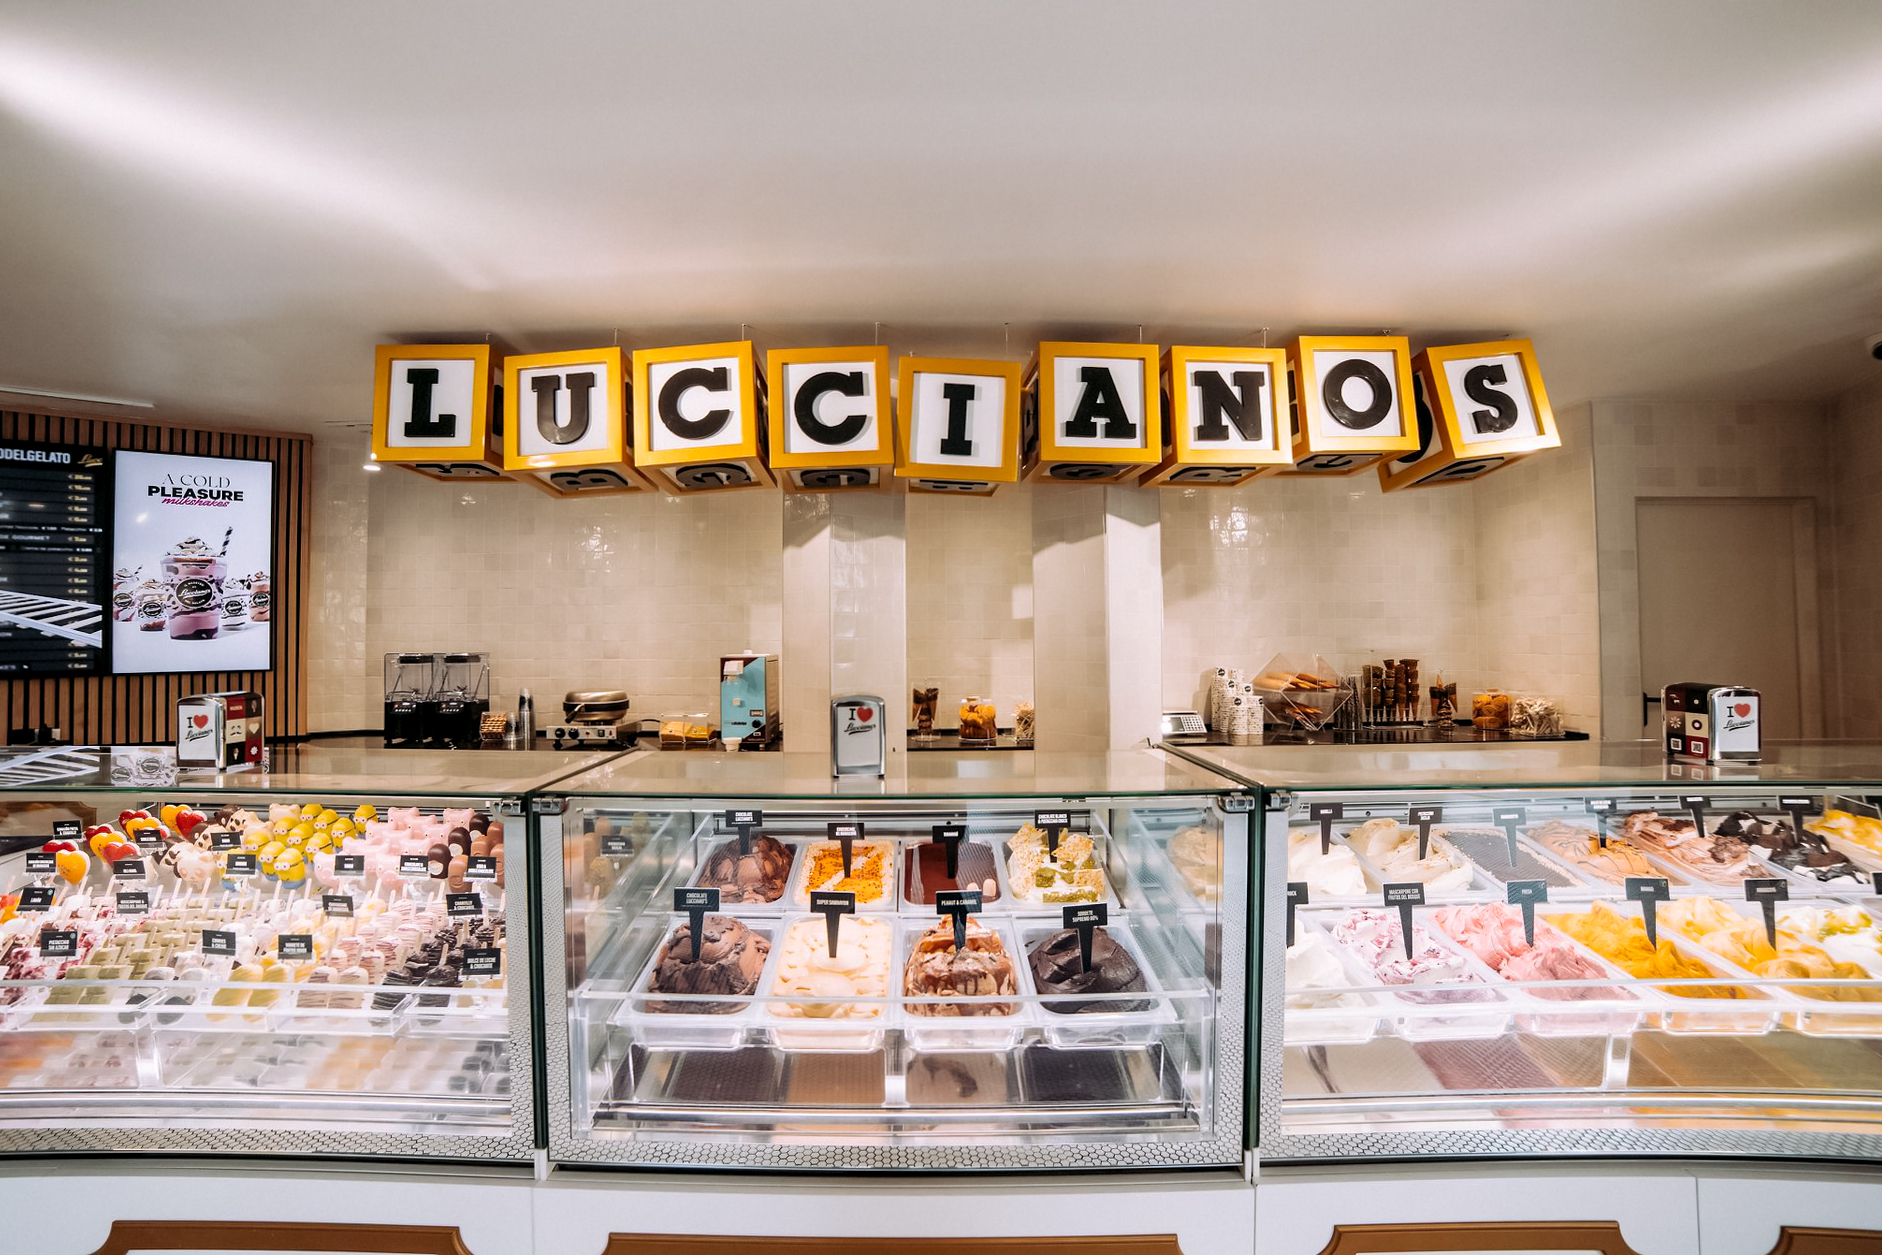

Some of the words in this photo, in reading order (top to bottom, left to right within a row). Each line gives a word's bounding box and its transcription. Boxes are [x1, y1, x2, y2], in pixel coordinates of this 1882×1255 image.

[162, 473, 174, 486] A
[180, 475, 231, 489] COLD
[148, 485, 243, 502] PLEASURE
[161, 496, 231, 508] milkshakes
